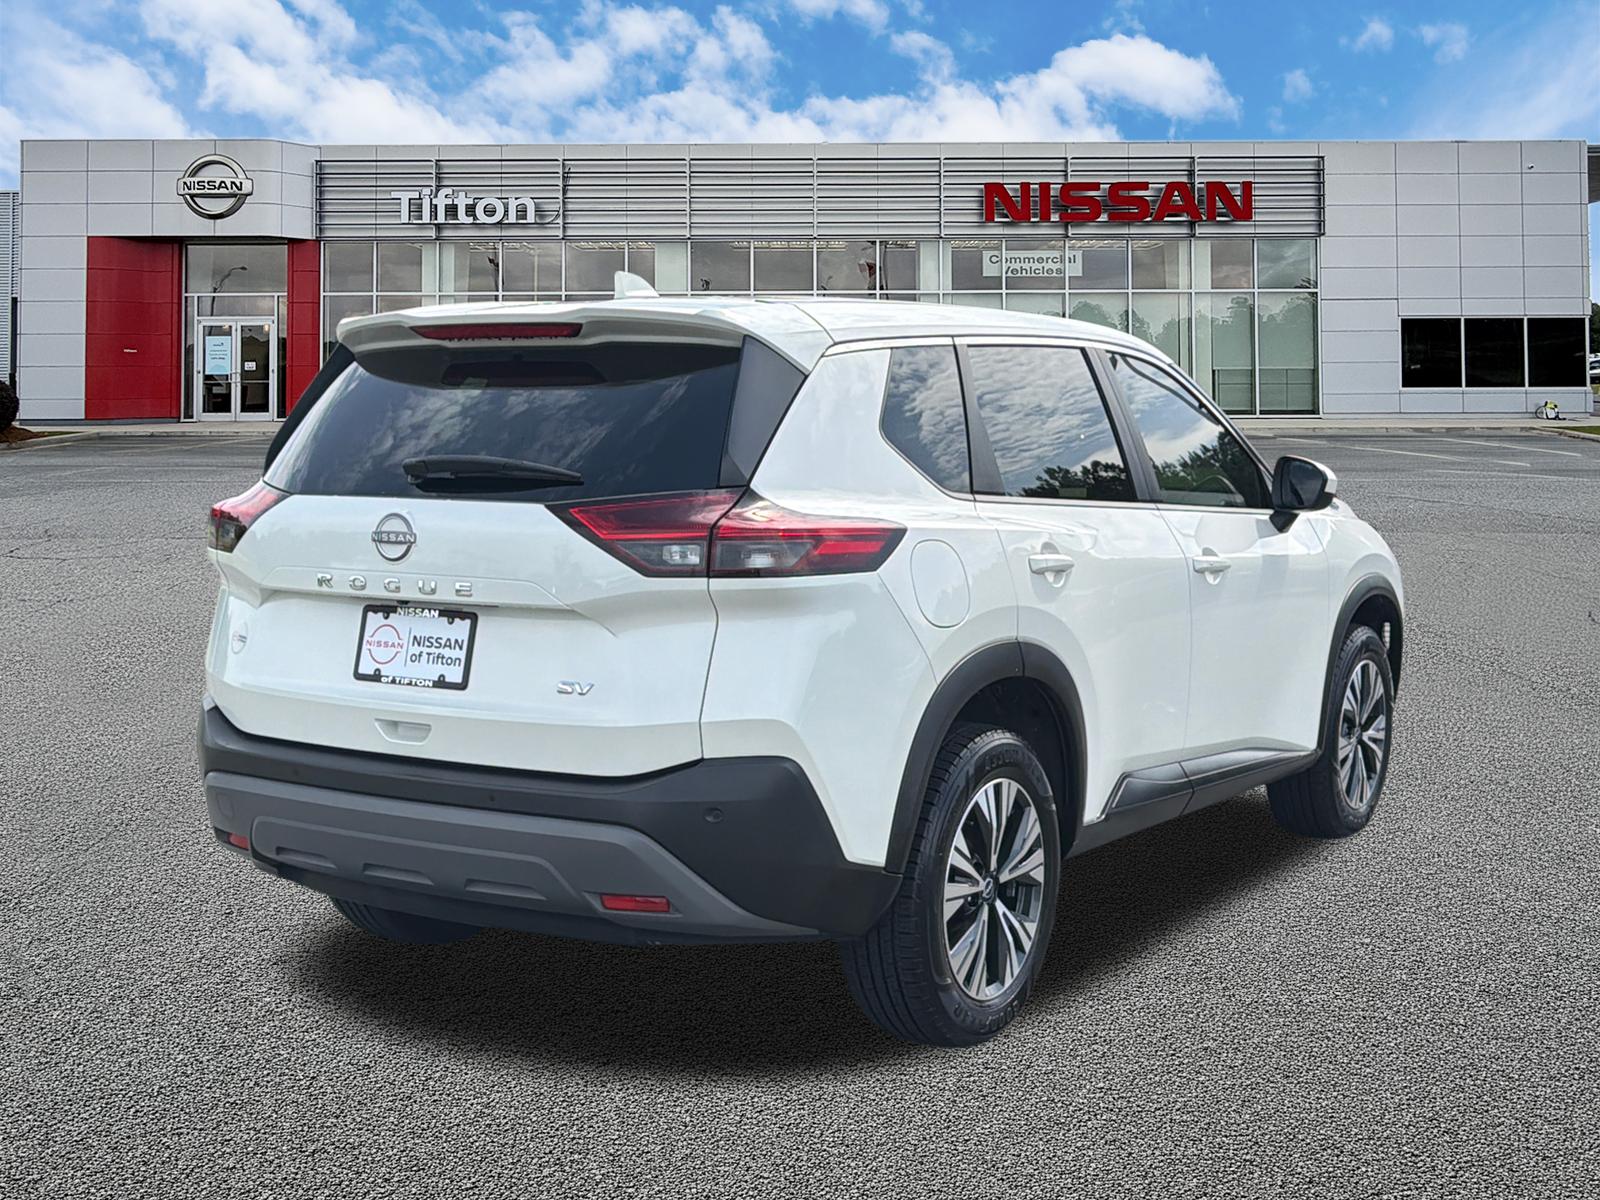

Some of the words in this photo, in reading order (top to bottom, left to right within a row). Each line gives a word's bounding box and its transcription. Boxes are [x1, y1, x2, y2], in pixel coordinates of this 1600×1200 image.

[182, 180, 243, 191] NISSAN
[391, 188, 536, 224] Tifton
[983, 180, 1253, 223] NISSAN
[372, 532, 415, 543] NISSAN
[317, 573, 474, 598] ROGUE
[396, 606, 440, 619] NISSAN
[365, 639, 405, 650] NISSAN
[411, 635, 465, 652] NISSAN
[409, 651, 425, 664] of
[426, 652, 462, 668] Tifton
[380, 676, 392, 684] of
[395, 677, 434, 688] TIFTON
[557, 680, 595, 696] SV
